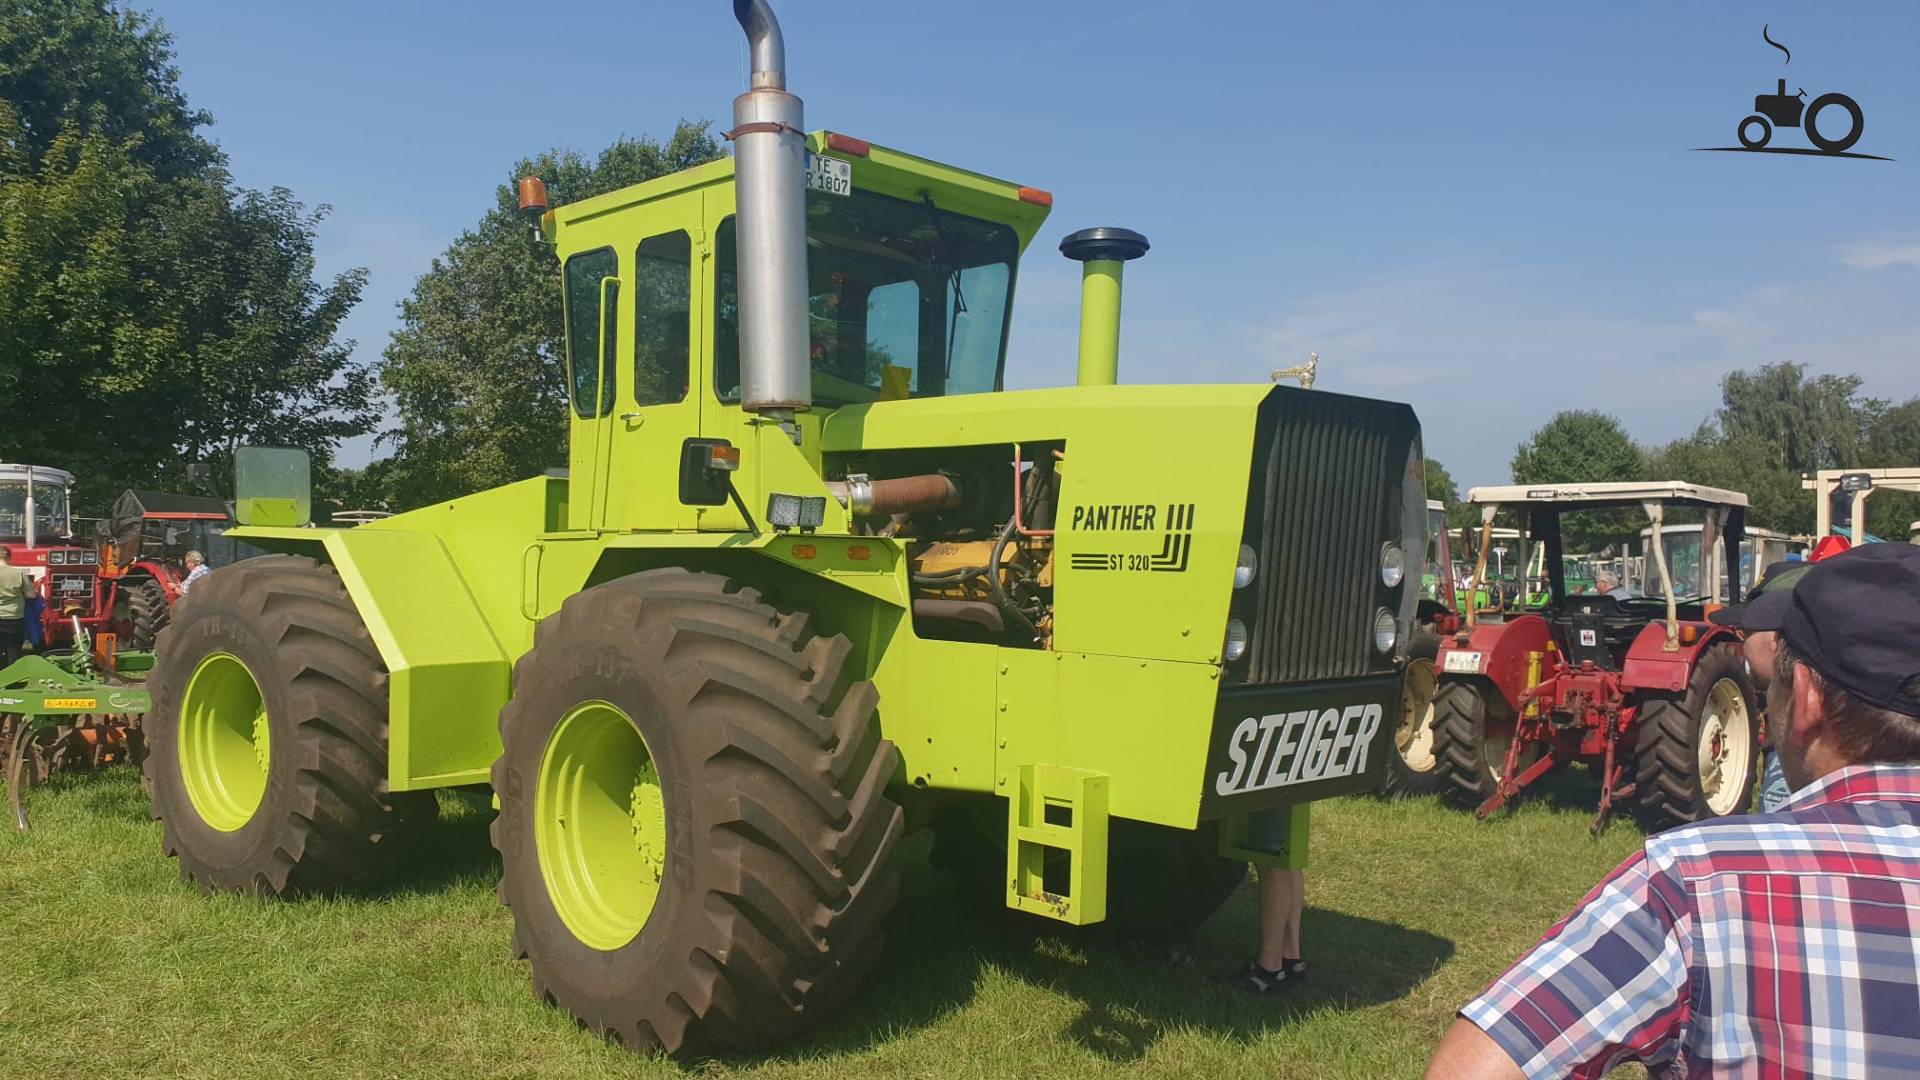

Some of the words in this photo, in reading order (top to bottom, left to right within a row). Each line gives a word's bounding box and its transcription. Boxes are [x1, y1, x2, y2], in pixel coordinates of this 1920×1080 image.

[816, 156, 831, 174] TE
[818, 174, 848, 193] 1807
[1072, 504, 1156, 531] PANTHER
[1110, 554, 1124, 571] ST
[1128, 554, 1149, 571] 320
[1215, 703, 1382, 796] STEIGER
